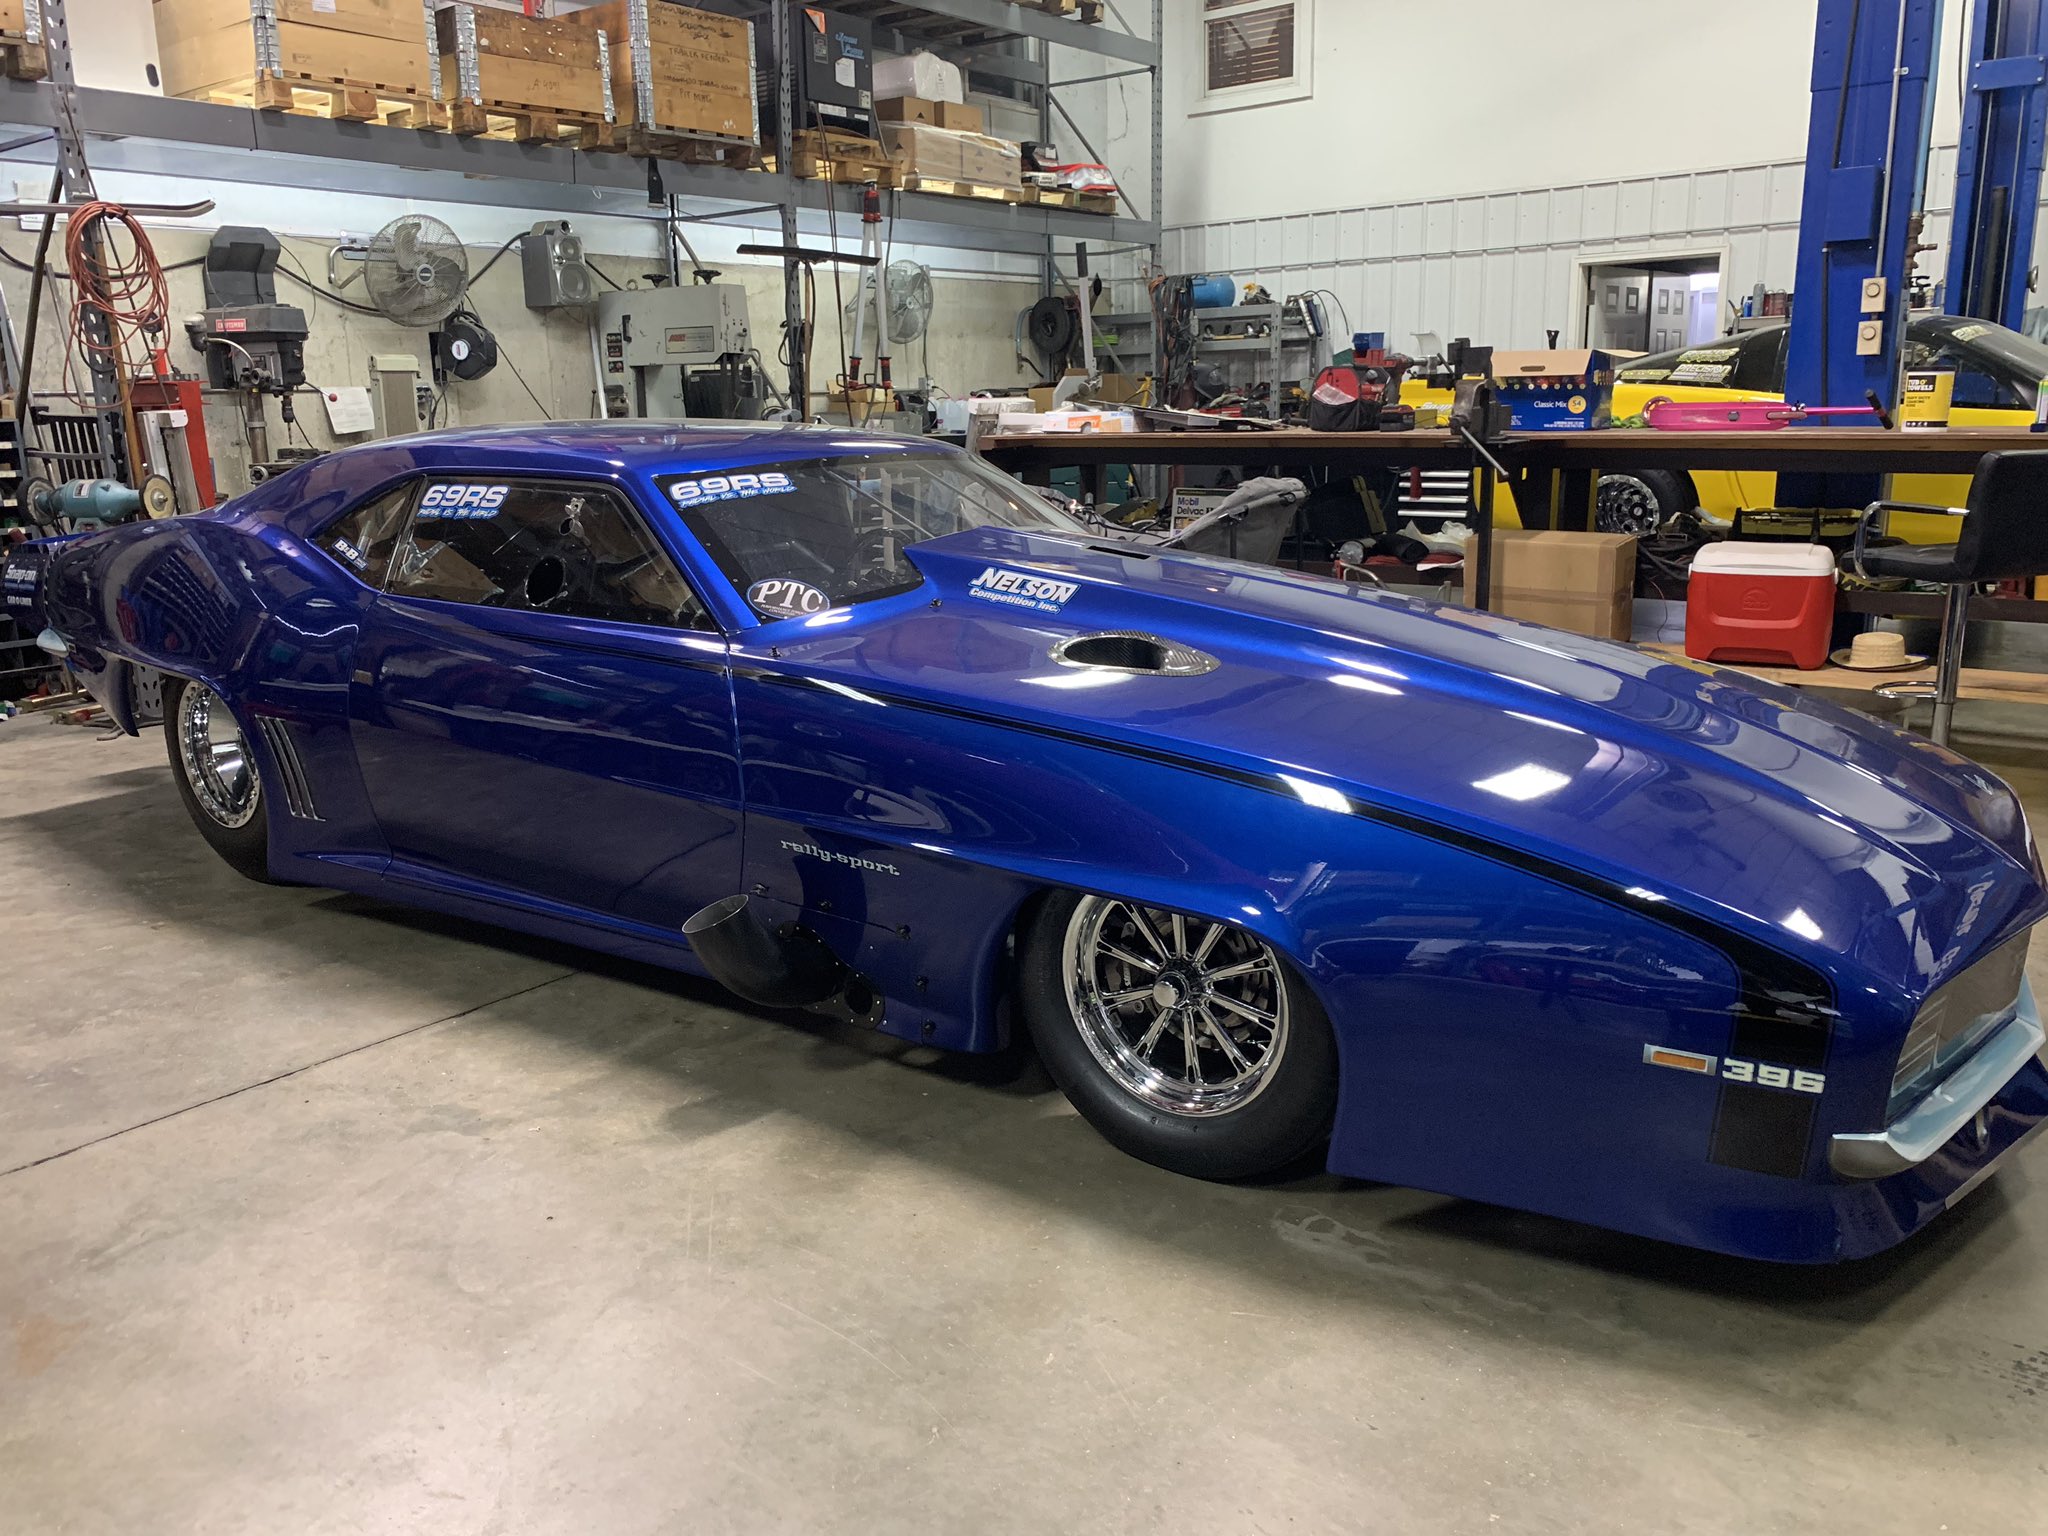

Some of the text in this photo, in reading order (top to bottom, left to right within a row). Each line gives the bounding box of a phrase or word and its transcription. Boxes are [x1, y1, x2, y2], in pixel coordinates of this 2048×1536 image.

[1533, 400, 1555, 409] Classic
[1555, 400, 1568, 409] Mix
[421, 485, 509, 508] 69RS
[671, 471, 789, 501] 69RS
[1176, 506, 1204, 515] Delvac
[1177, 497, 1200, 506] Mobil
[5, 563, 37, 584] Snap-on
[970, 567, 1080, 604] NELSON
[753, 580, 824, 613] PTC
[969, 586, 1060, 614] Competition Inc.
[780, 839, 901, 876] rally-sport
[1722, 1057, 1826, 1094] 396
